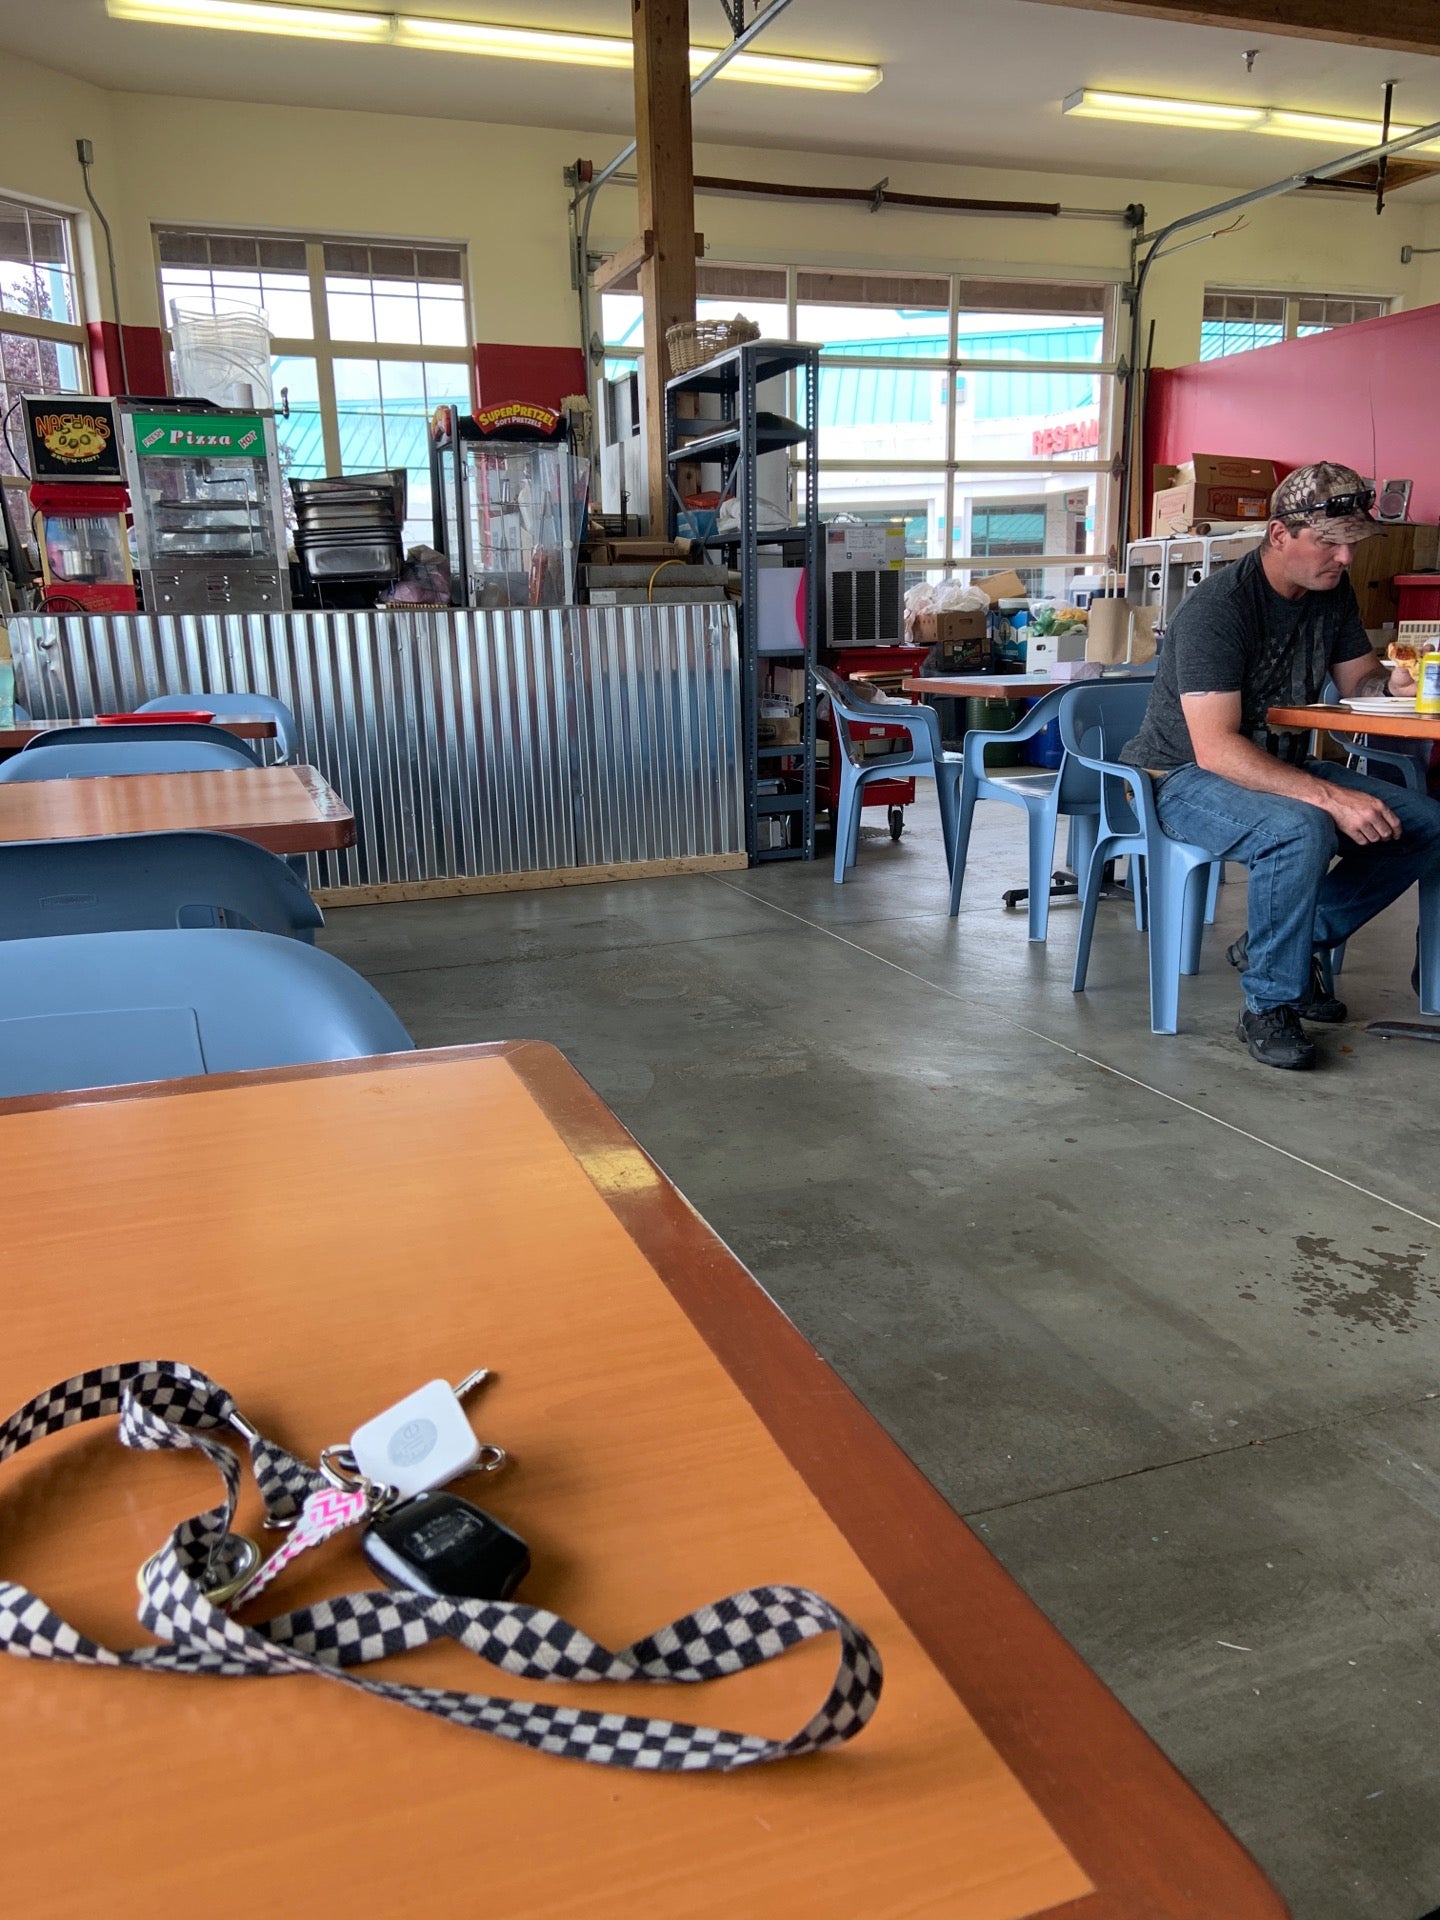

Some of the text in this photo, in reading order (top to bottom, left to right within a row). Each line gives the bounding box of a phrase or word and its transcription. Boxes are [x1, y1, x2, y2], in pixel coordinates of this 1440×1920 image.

[35, 414, 111, 439] NACHOS
[494, 416, 543, 428] SOFT PRETZELS
[143, 429, 163, 446] FRESH
[169, 430, 232, 446] Pizza
[239, 431, 258, 448] HOT
